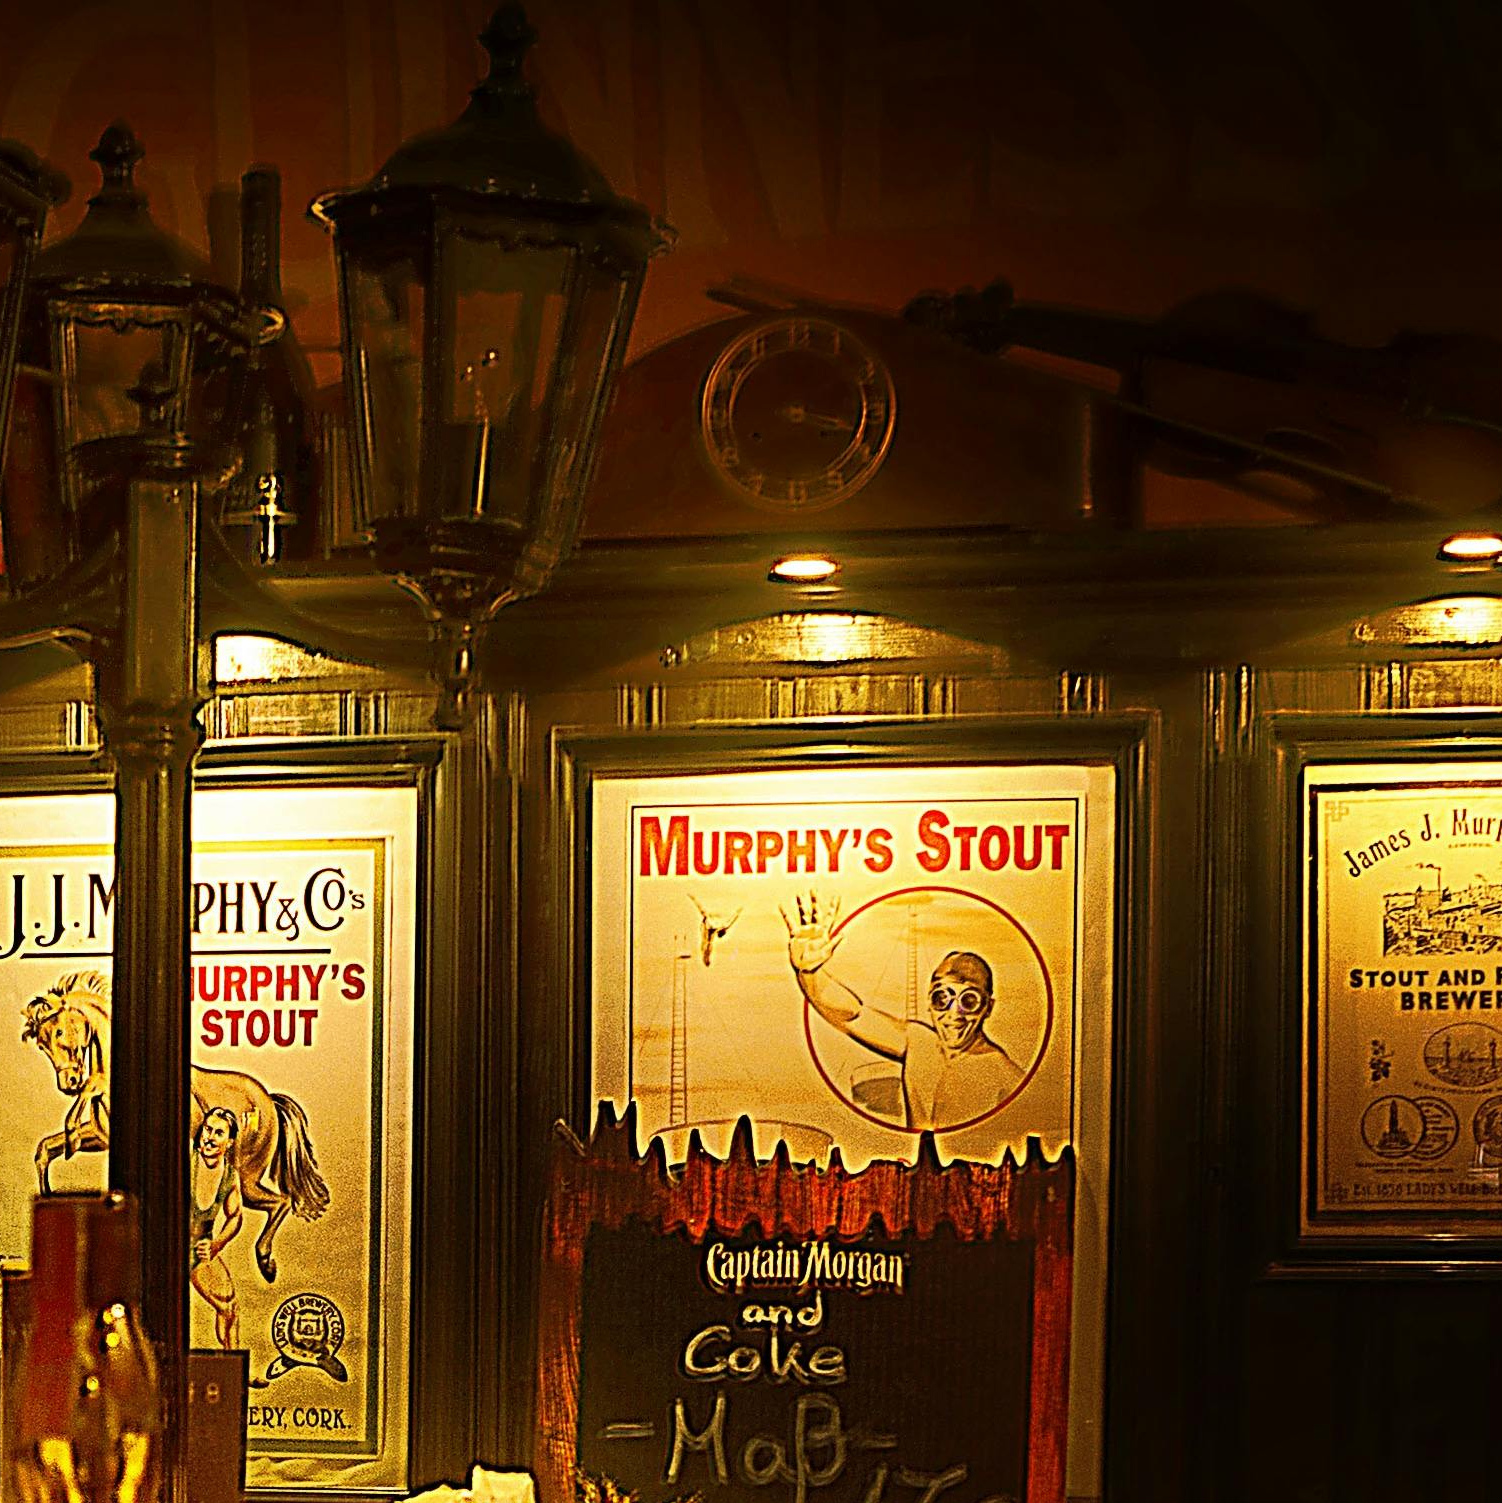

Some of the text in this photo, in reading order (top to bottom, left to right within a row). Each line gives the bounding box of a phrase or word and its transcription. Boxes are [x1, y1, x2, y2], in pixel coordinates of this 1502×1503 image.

[639, 808, 1071, 877] MURPHY'S STOUT
[1344, 828, 1411, 878] James
[1420, 813, 1441, 842] J.
[191, 963, 366, 1002] URPHY'S
[1348, 968, 1431, 989] STOUT
[1437, 969, 1486, 987] AND
[200, 1008, 319, 1048] STOUT
[705, 1240, 906, 1292] Captain Morgan
[741, 1290, 824, 1328] and
[684, 1324, 847, 1384] Coke
